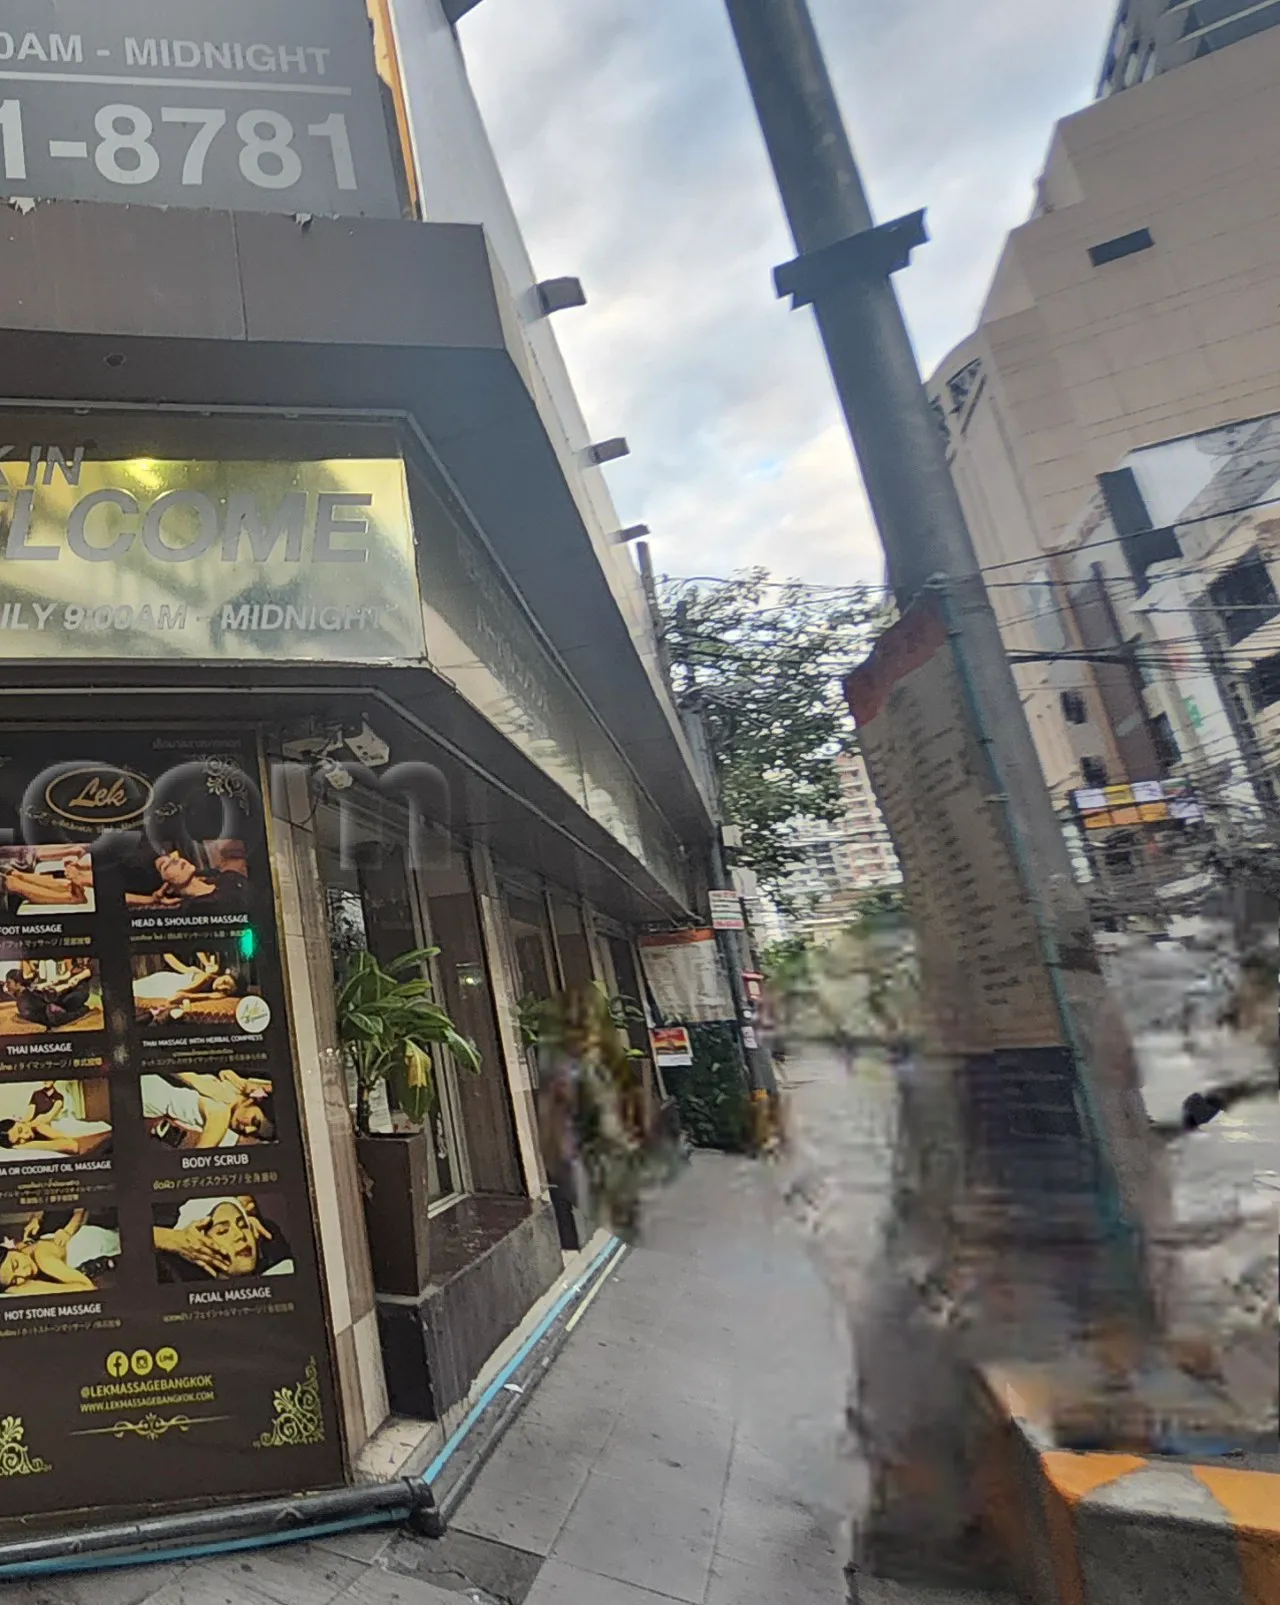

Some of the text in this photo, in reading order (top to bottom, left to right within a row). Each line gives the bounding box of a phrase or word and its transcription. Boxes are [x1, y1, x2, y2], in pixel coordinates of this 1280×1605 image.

[123, 38, 331, 76] MIDNIGHT
[26, 446, 85, 487] IN
[62, 602, 187, 632] 9:00AM
[220, 602, 390, 633] MIDNIGHT
[68, 776, 128, 808] Lek
[21, 924, 62, 934] MASSAGE
[131, 914, 249, 928] HEAD & SHOULDER MASSAGE
[6, 1042, 73, 1055] THAI MASSAGE
[143, 1040, 157, 1048] THAI
[158, 1038, 187, 1047] MASSAGE
[189, 1037, 205, 1045] WITH
[8, 1166, 20, 1175] OR
[21, 1163, 59, 1174] COCONUT
[60, 1163, 74, 1172] OIL
[75, 1160, 111, 1171] MASSAGE
[182, 1154, 249, 1169] BODY SCRUB
[189, 1287, 272, 1304] FACIAL MASSAGE
[4, 1303, 102, 1321] HOT STONE MASSAGE
[80, 1374, 213, 1399] @LEKMASSAGEBANGKOK
[80, 1391, 214, 1413] WWW.LEKMASSAGEBANGKOK.COM
